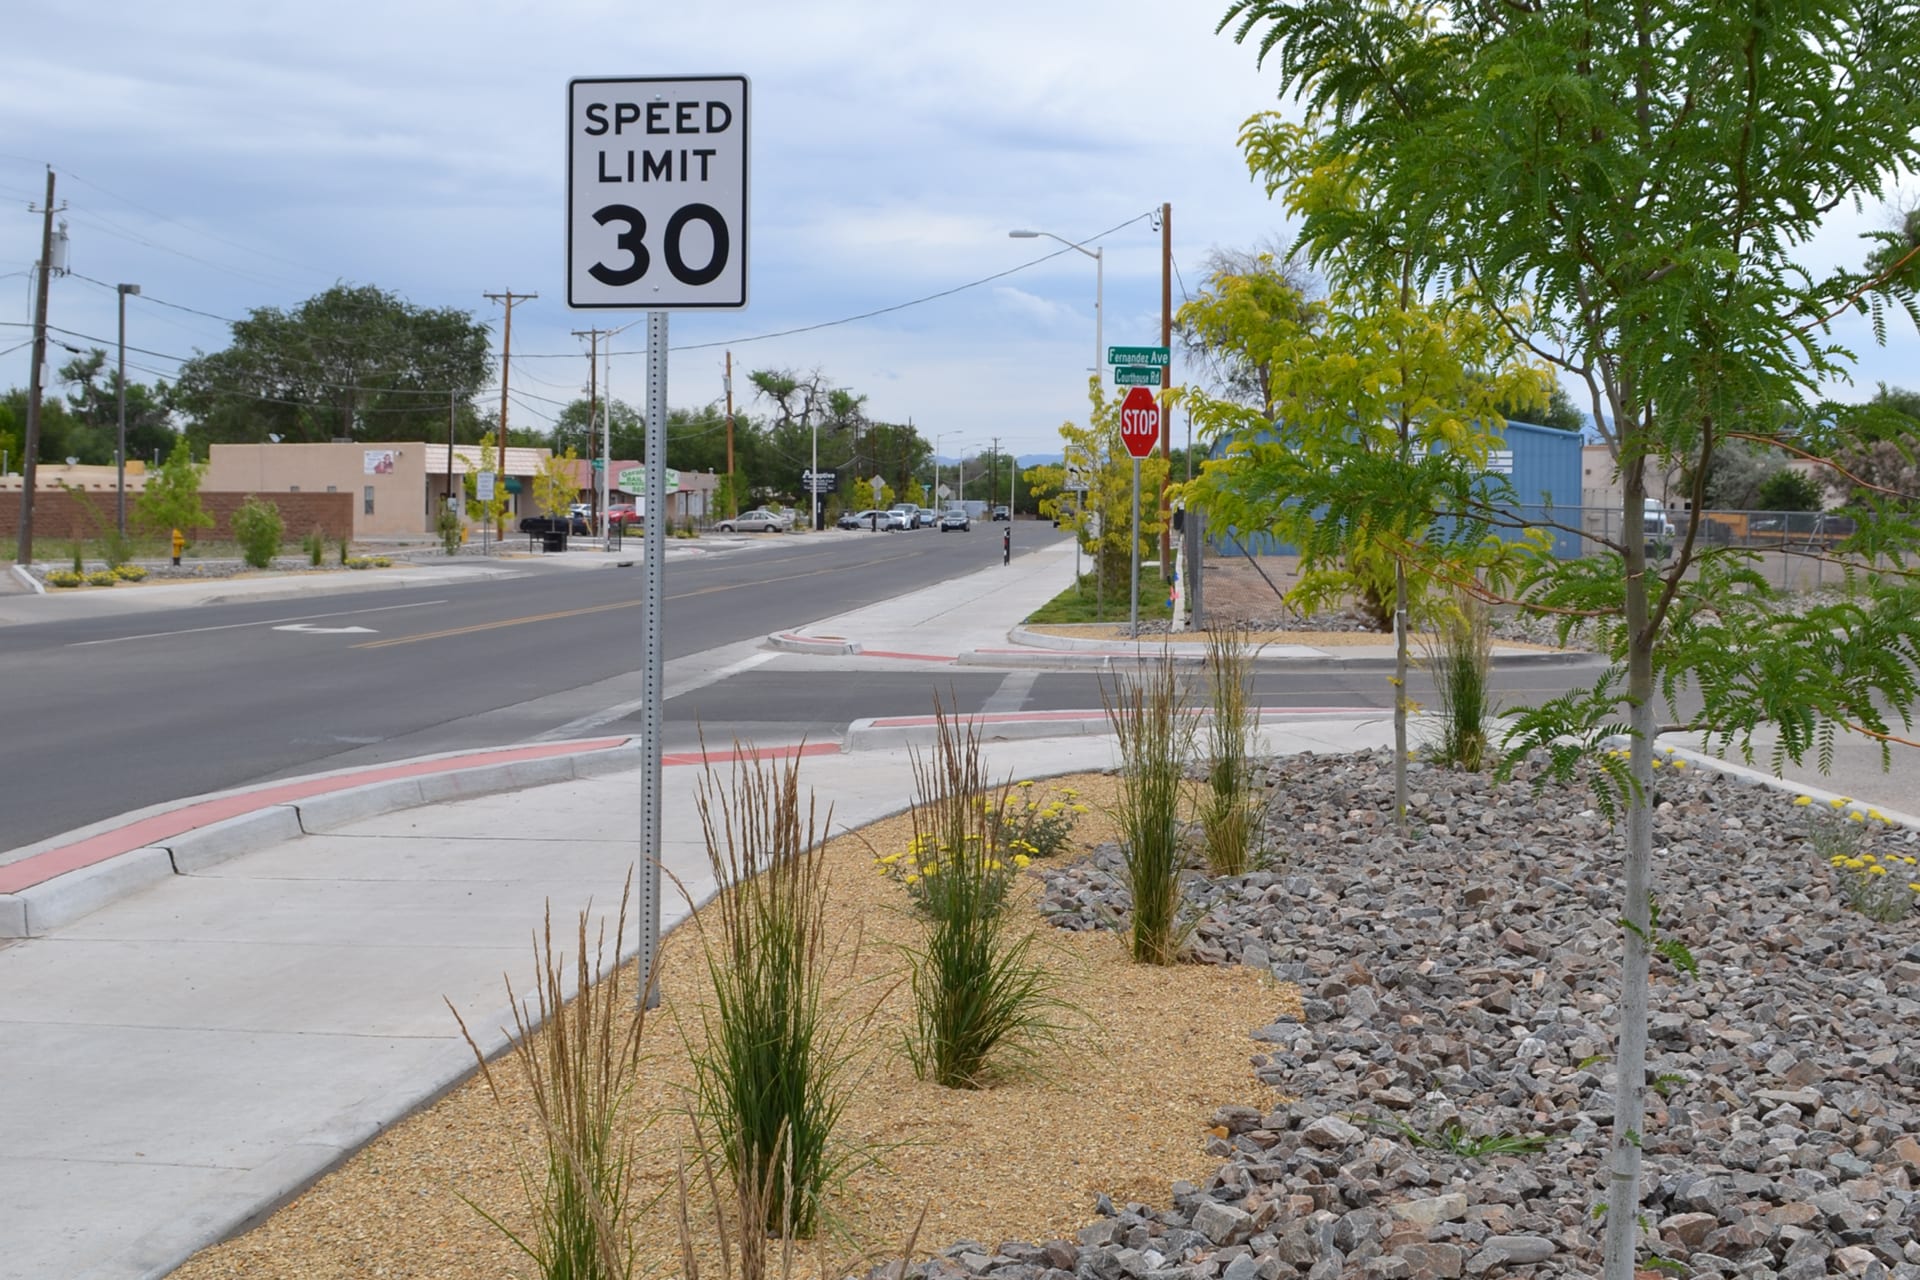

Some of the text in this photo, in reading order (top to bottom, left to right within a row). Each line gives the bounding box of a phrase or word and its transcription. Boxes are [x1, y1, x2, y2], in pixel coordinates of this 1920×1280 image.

[584, 101, 732, 136] SPEED
[598, 149, 717, 183] LIMIT
[587, 203, 730, 287] 30
[1109, 348, 1169, 364] Fernandez Ave
[1116, 368, 1160, 384] Courthouse Rd
[1123, 408, 1157, 435] STOP
[802, 469, 836, 480] Aptive
